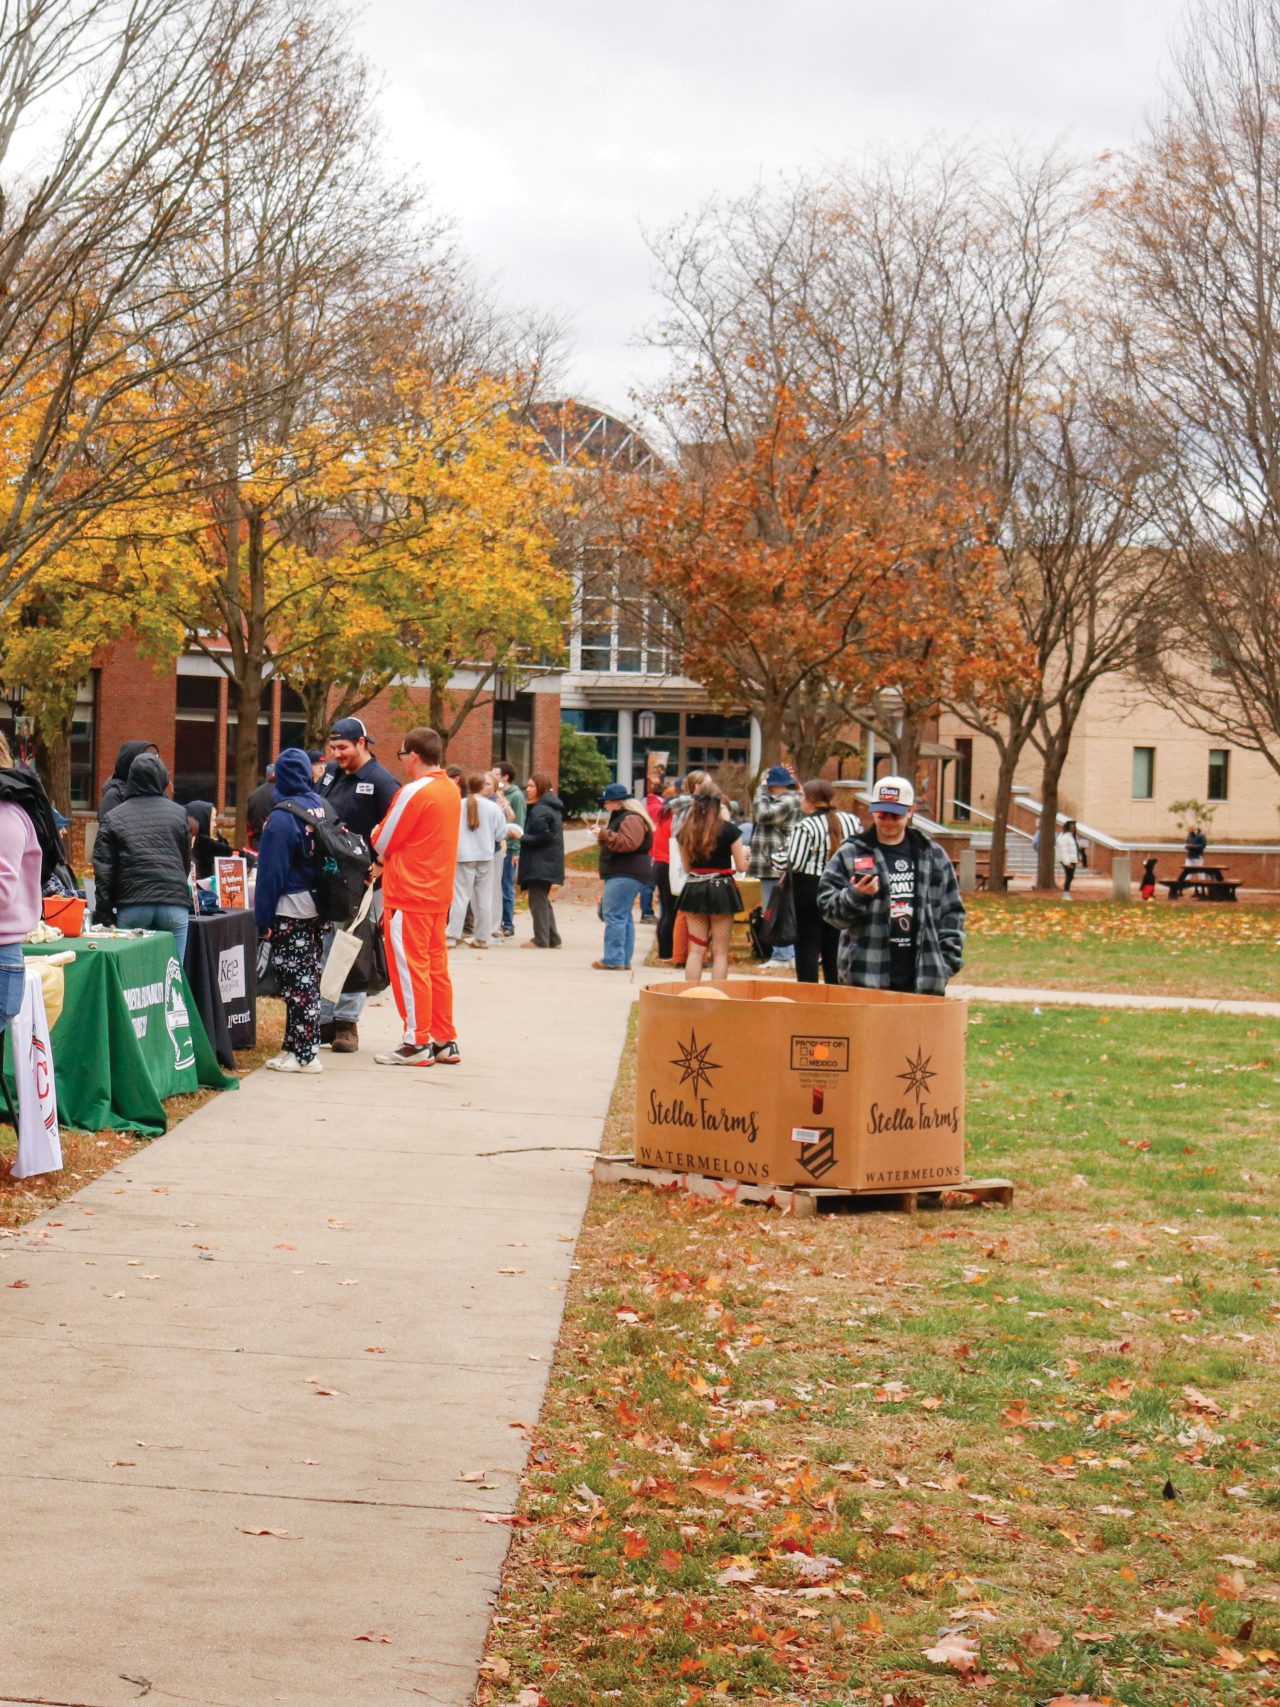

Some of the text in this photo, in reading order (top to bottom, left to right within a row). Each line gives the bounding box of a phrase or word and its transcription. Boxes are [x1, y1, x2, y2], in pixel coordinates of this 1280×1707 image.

[808, 1059, 838, 1067] MEXICO
[647, 1088, 760, 1143] Stella Farms
[867, 1102, 960, 1135] Stella Farms
[640, 1146, 770, 1178] WATERMELONS
[865, 1165, 960, 1182] WATERMELONS
